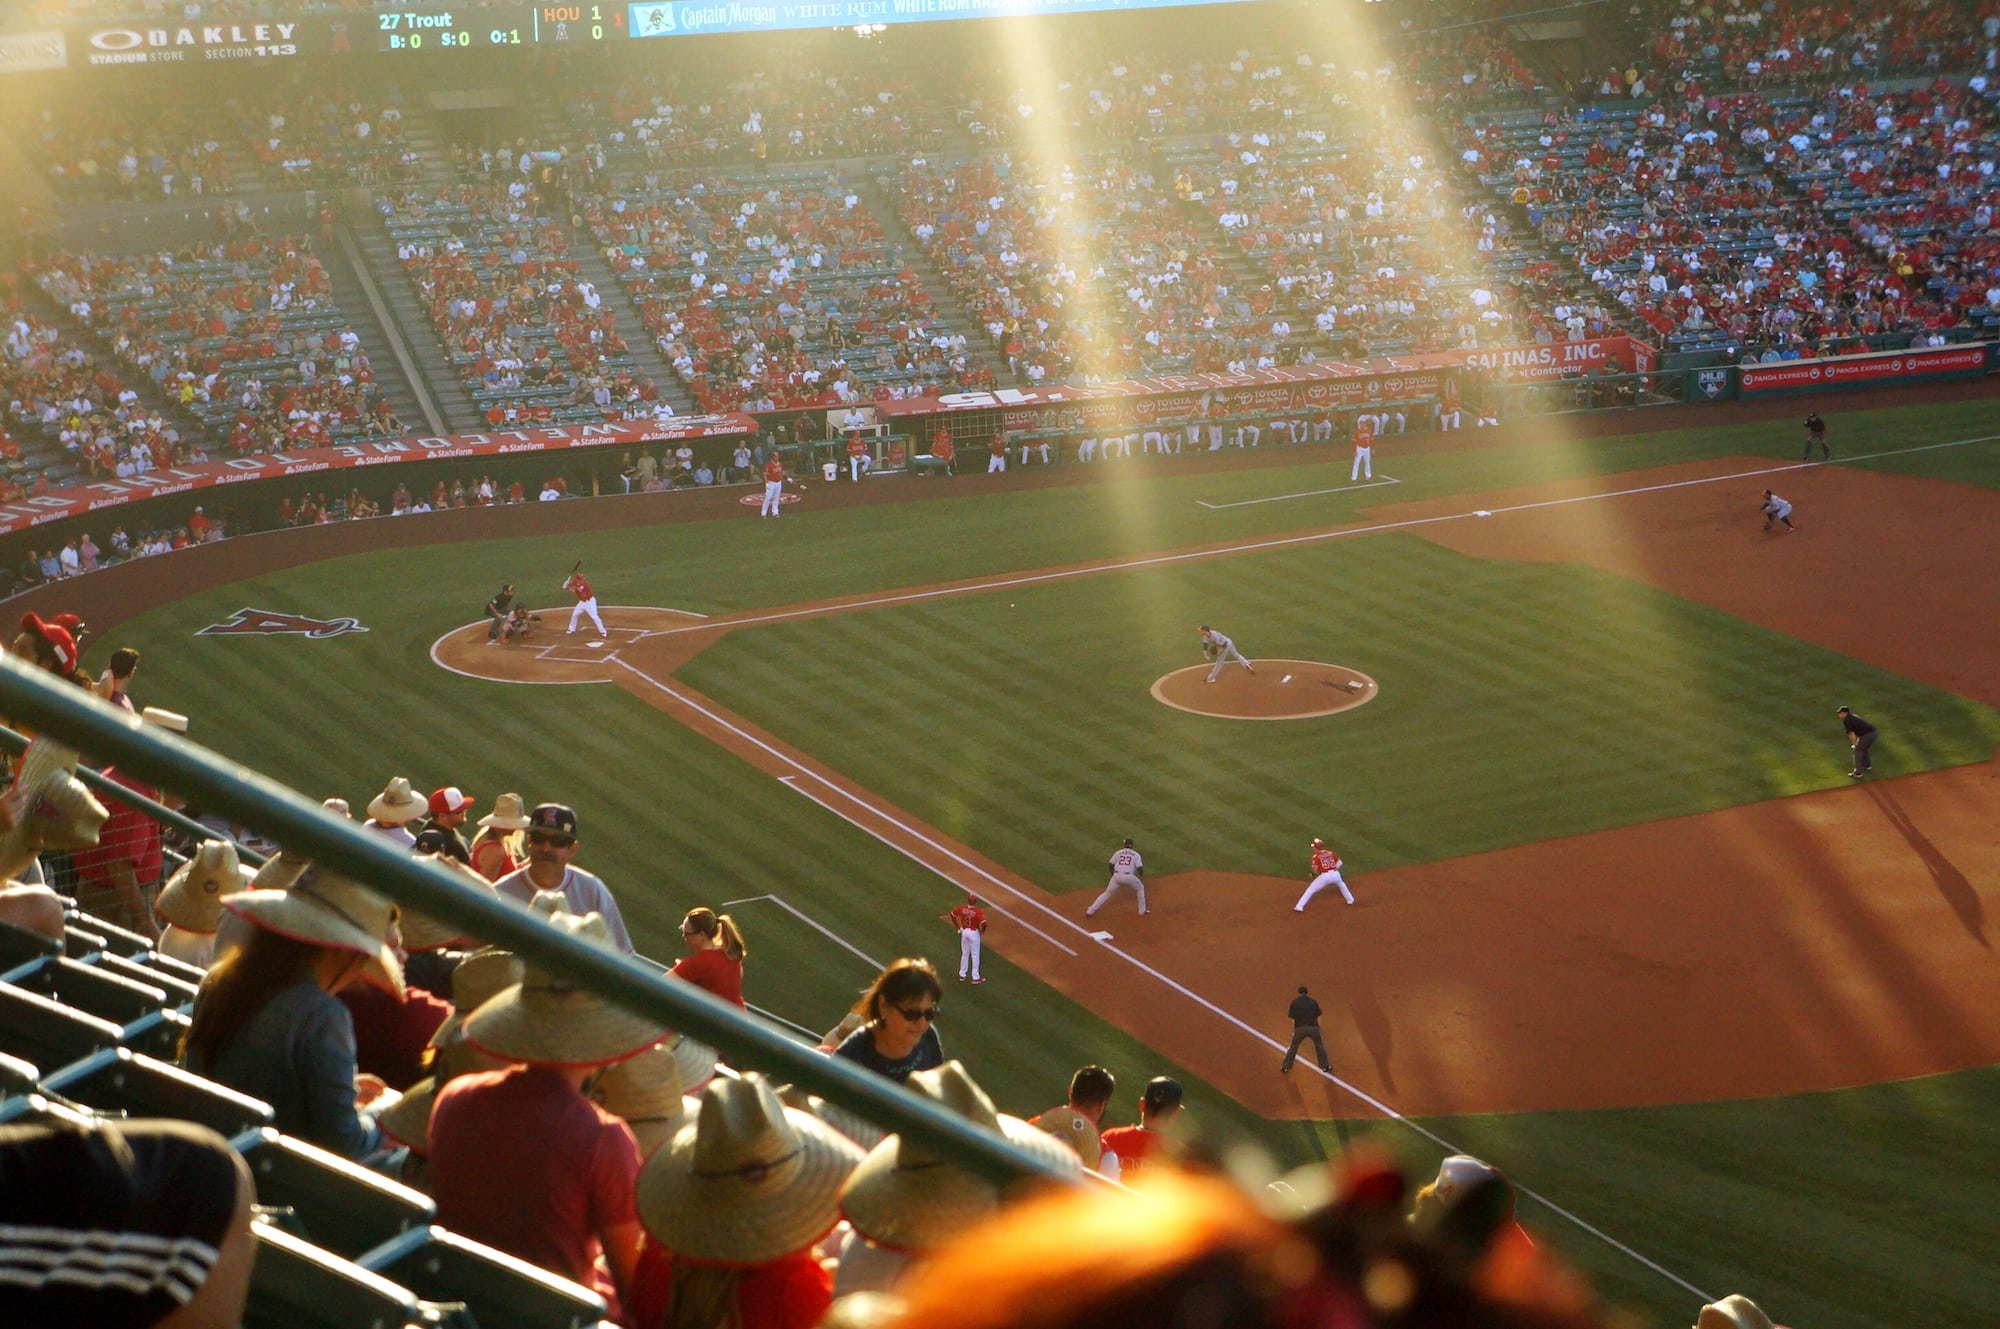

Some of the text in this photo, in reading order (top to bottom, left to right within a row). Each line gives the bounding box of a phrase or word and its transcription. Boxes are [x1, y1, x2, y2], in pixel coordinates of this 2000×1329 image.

[544, 6, 602, 22] HOU 1
[893, 0, 936, 14] WHITE
[380, 12, 453, 30] 27 Trout
[681, 0, 887, 29] Captain Morgan WHITE RUM
[149, 24, 295, 46] OAKLEY
[441, 32, 470, 46] S: 0
[510, 29, 521, 44] 1
[592, 25, 603, 40] 0
[390, 34, 421, 48] B: 0
[91, 51, 185, 65] STADIUM STORE
[206, 44, 297, 59] SECTION 113
[1564, 343, 1606, 361] INC.
[1917, 355, 1972, 367] PANDA EXPRESS
[1531, 364, 1582, 376] Contractor
[1836, 363, 1891, 374] PANDA EXPRESS
[1405, 376, 1438, 385] TOYOTA
[1700, 372, 1725, 380] MLB
[1753, 371, 1809, 382] PANDA EXPRESS
[1255, 389, 1288, 398] TOYOTA
[1328, 383, 1362, 392] TOYOTA
[1157, 397, 1191, 406] TOYOTA
[1005, 410, 1038, 420] TOYOTA
[1118, 855, 1132, 866] 23
